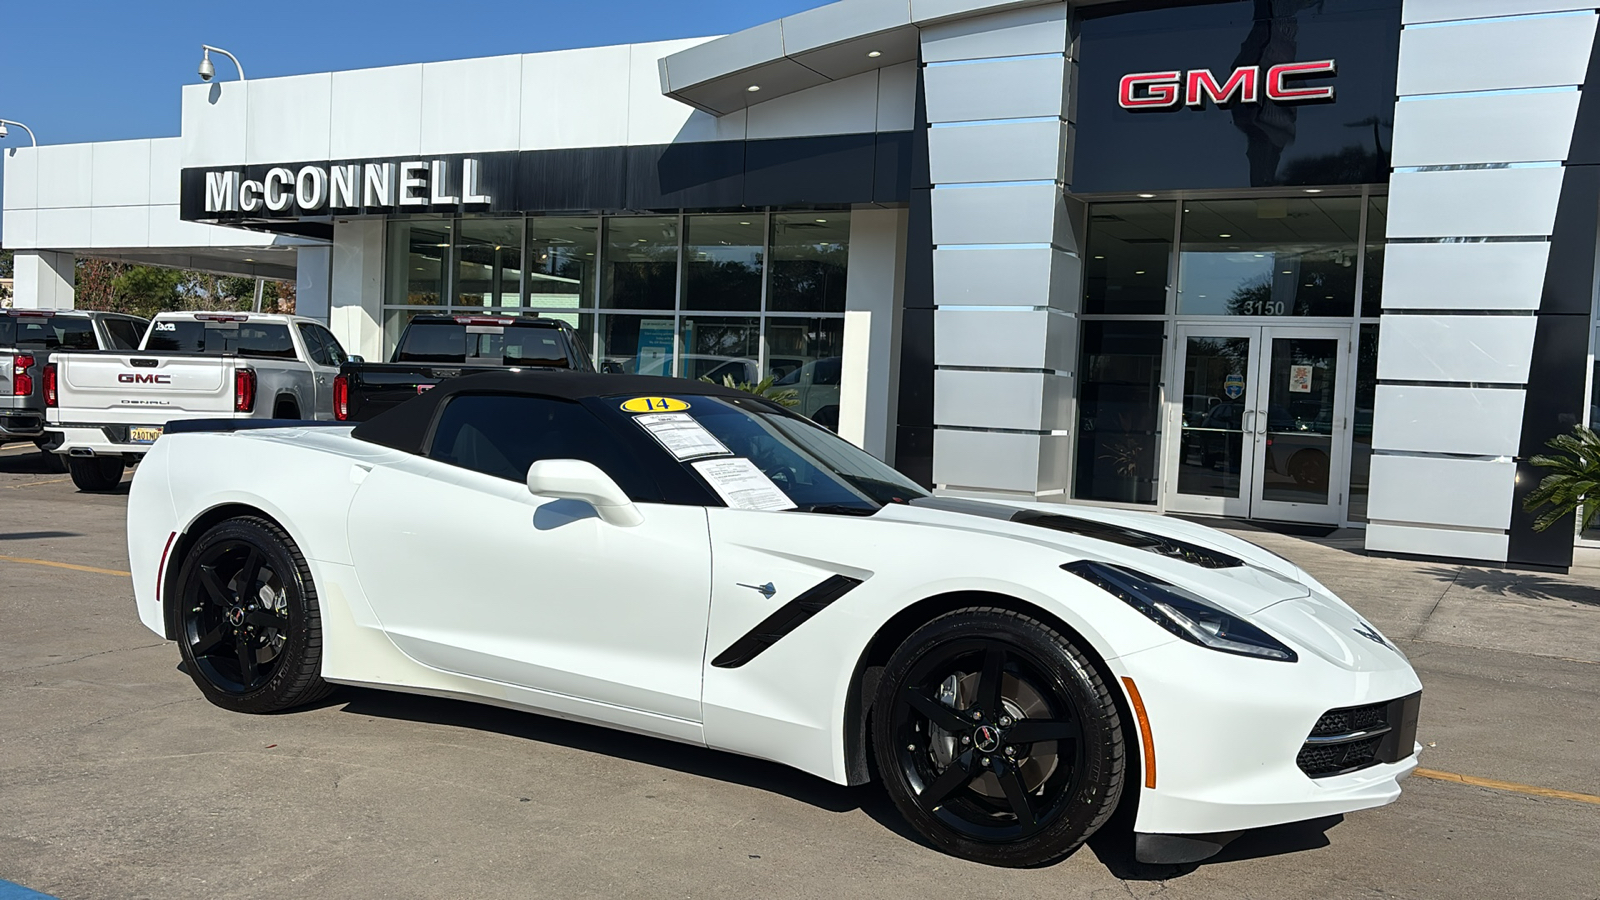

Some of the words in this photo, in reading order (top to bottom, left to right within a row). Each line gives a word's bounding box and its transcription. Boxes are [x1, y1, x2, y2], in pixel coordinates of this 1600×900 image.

[1118, 59, 1336, 110] GMC
[204, 158, 492, 212] McCONNELL
[1243, 300, 1285, 316] 3150
[117, 373, 171, 384] GMC
[643, 398, 670, 410] 14
